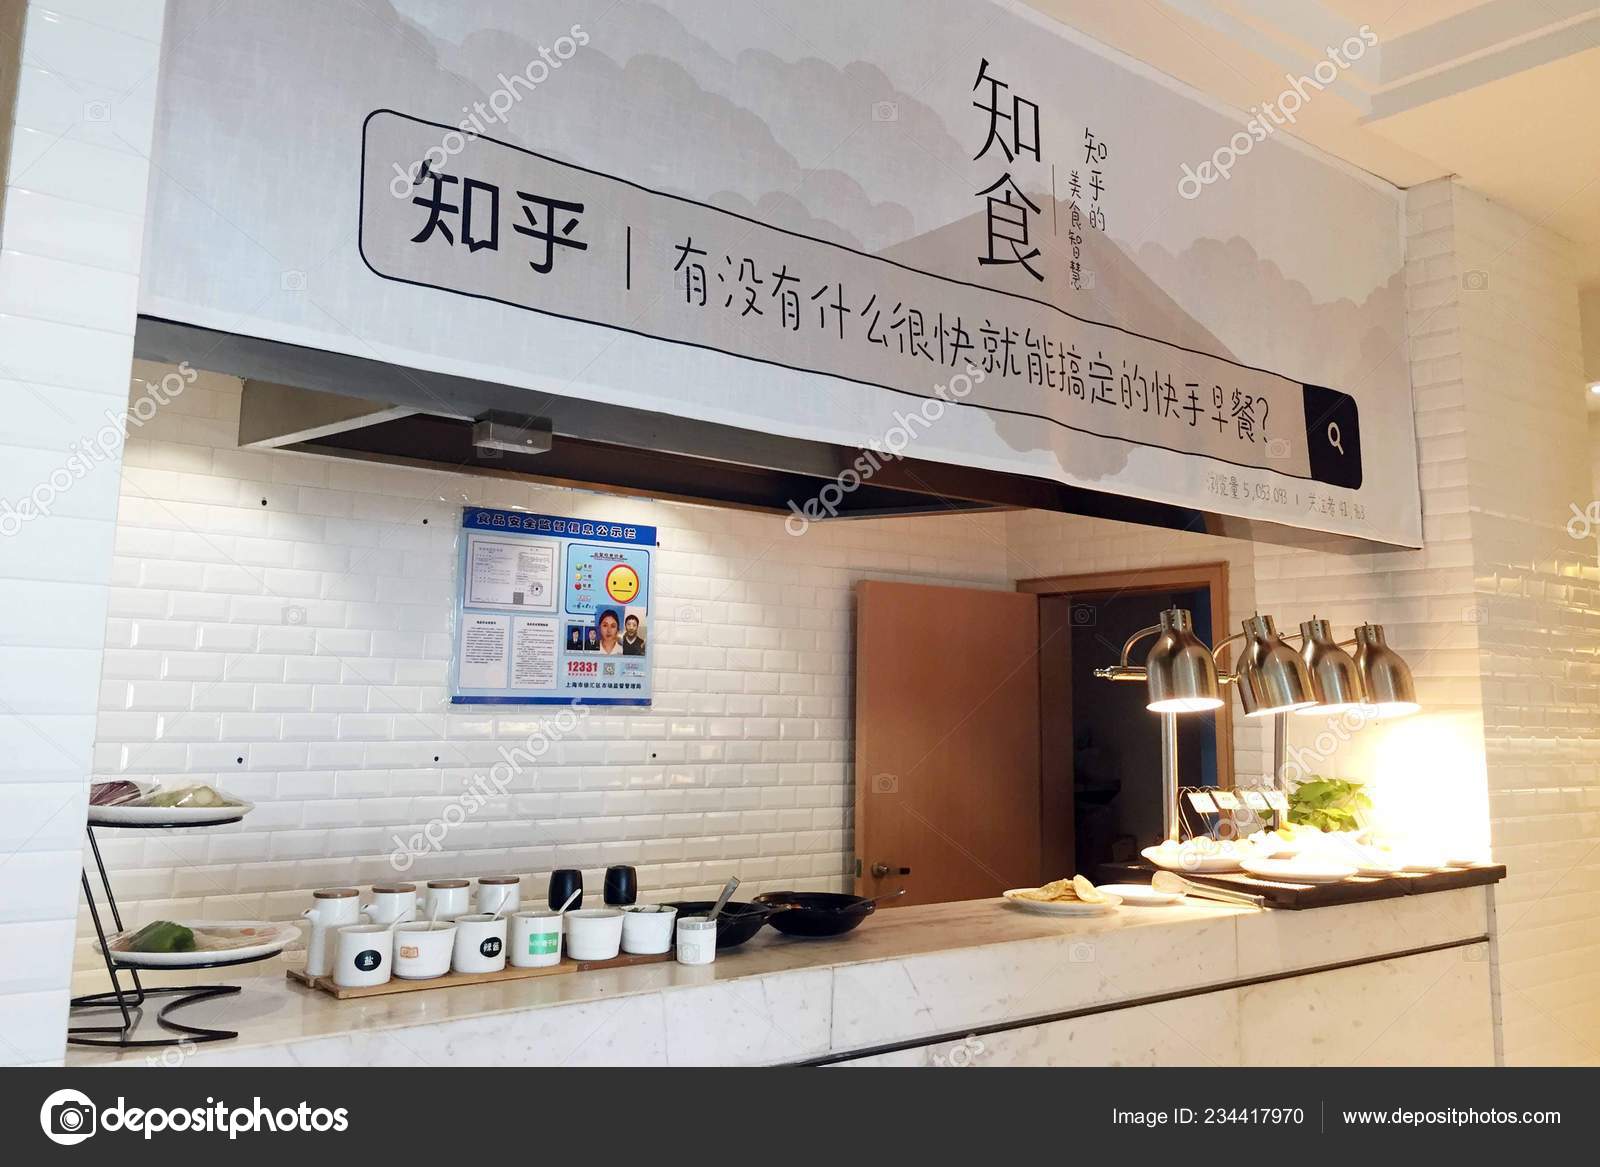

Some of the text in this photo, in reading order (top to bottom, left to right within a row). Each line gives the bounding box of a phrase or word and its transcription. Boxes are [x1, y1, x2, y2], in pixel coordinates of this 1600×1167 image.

[410, 158, 588, 274] 知乎
[973, 57, 1044, 282] 知食
[1084, 127, 1108, 231] 知乎的
[1068, 170, 1083, 290] 美食智慧
[476, 512, 637, 539] 食品安全监督信息公示栏
[567, 661, 598, 672] 12331
[363, 955, 375, 966] 盐
